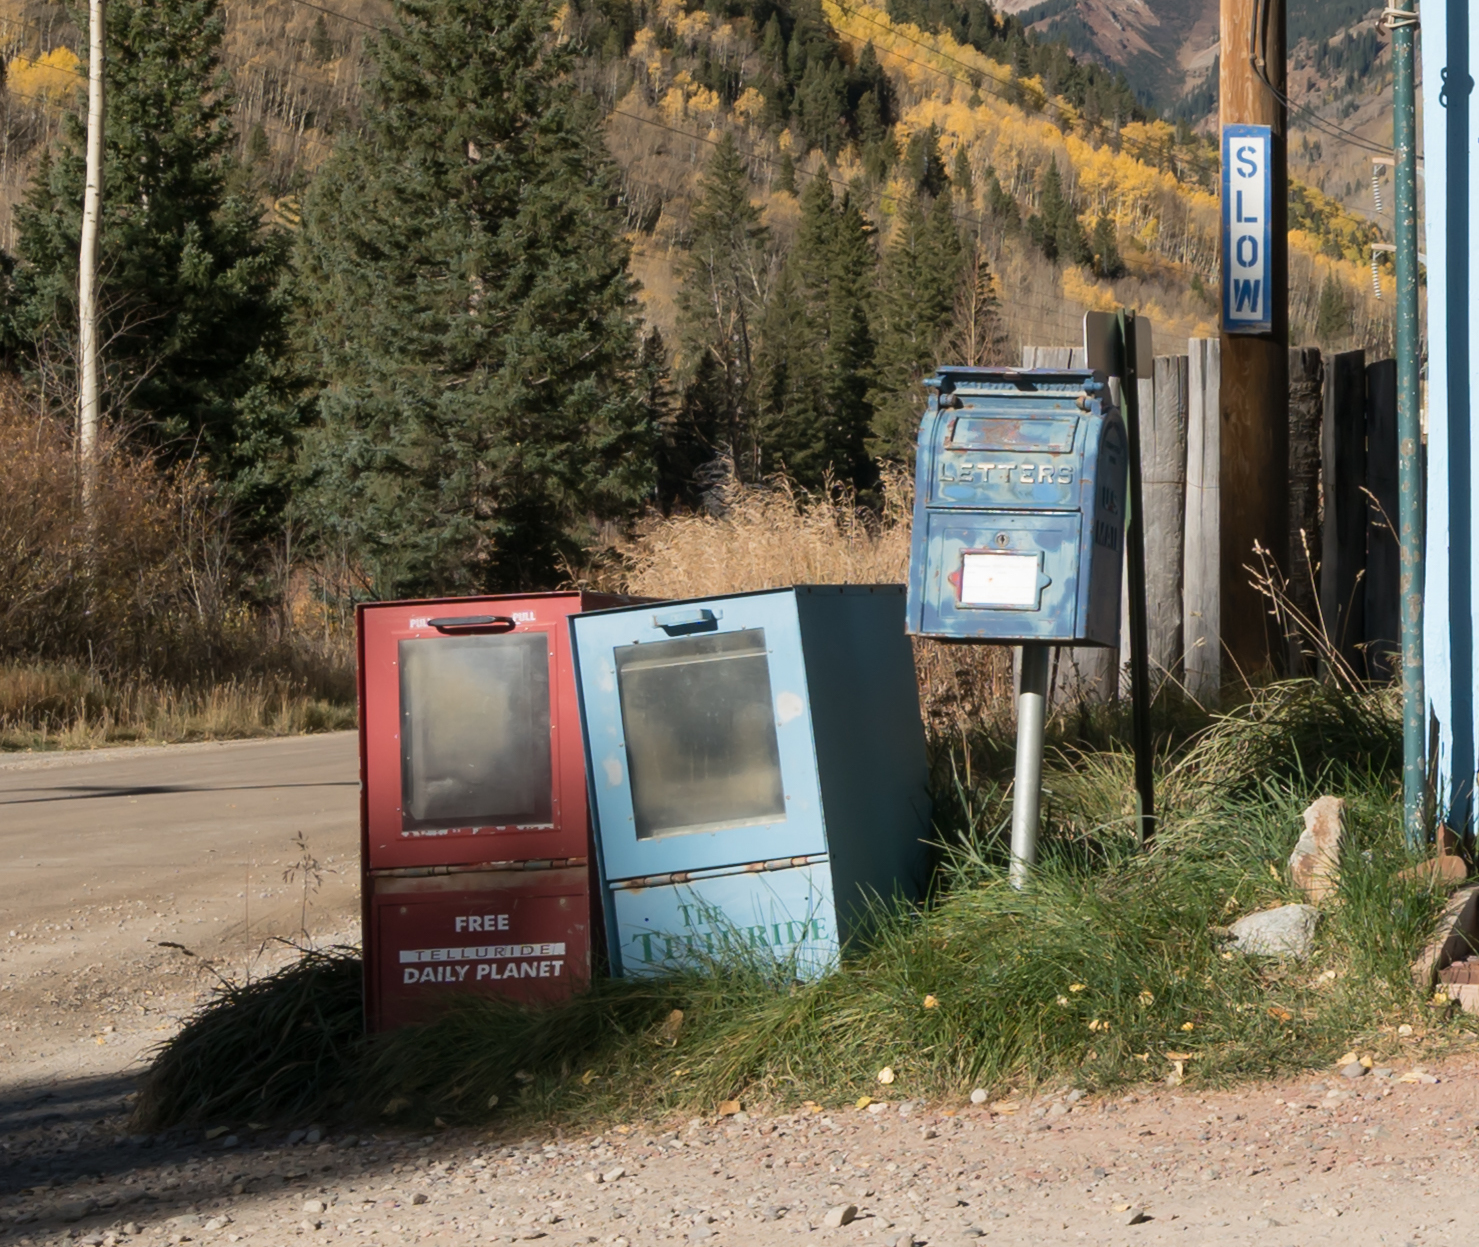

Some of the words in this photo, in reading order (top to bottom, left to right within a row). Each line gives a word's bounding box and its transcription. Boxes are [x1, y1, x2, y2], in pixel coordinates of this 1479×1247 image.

[1233, 146, 1261, 313] SLOW
[938, 462, 1075, 486] LETTERS
[455, 914, 510, 933] FREE
[415, 944, 551, 962] TELLURIDE
[403, 964, 470, 984] DAILY
[476, 960, 564, 981] PLANET
